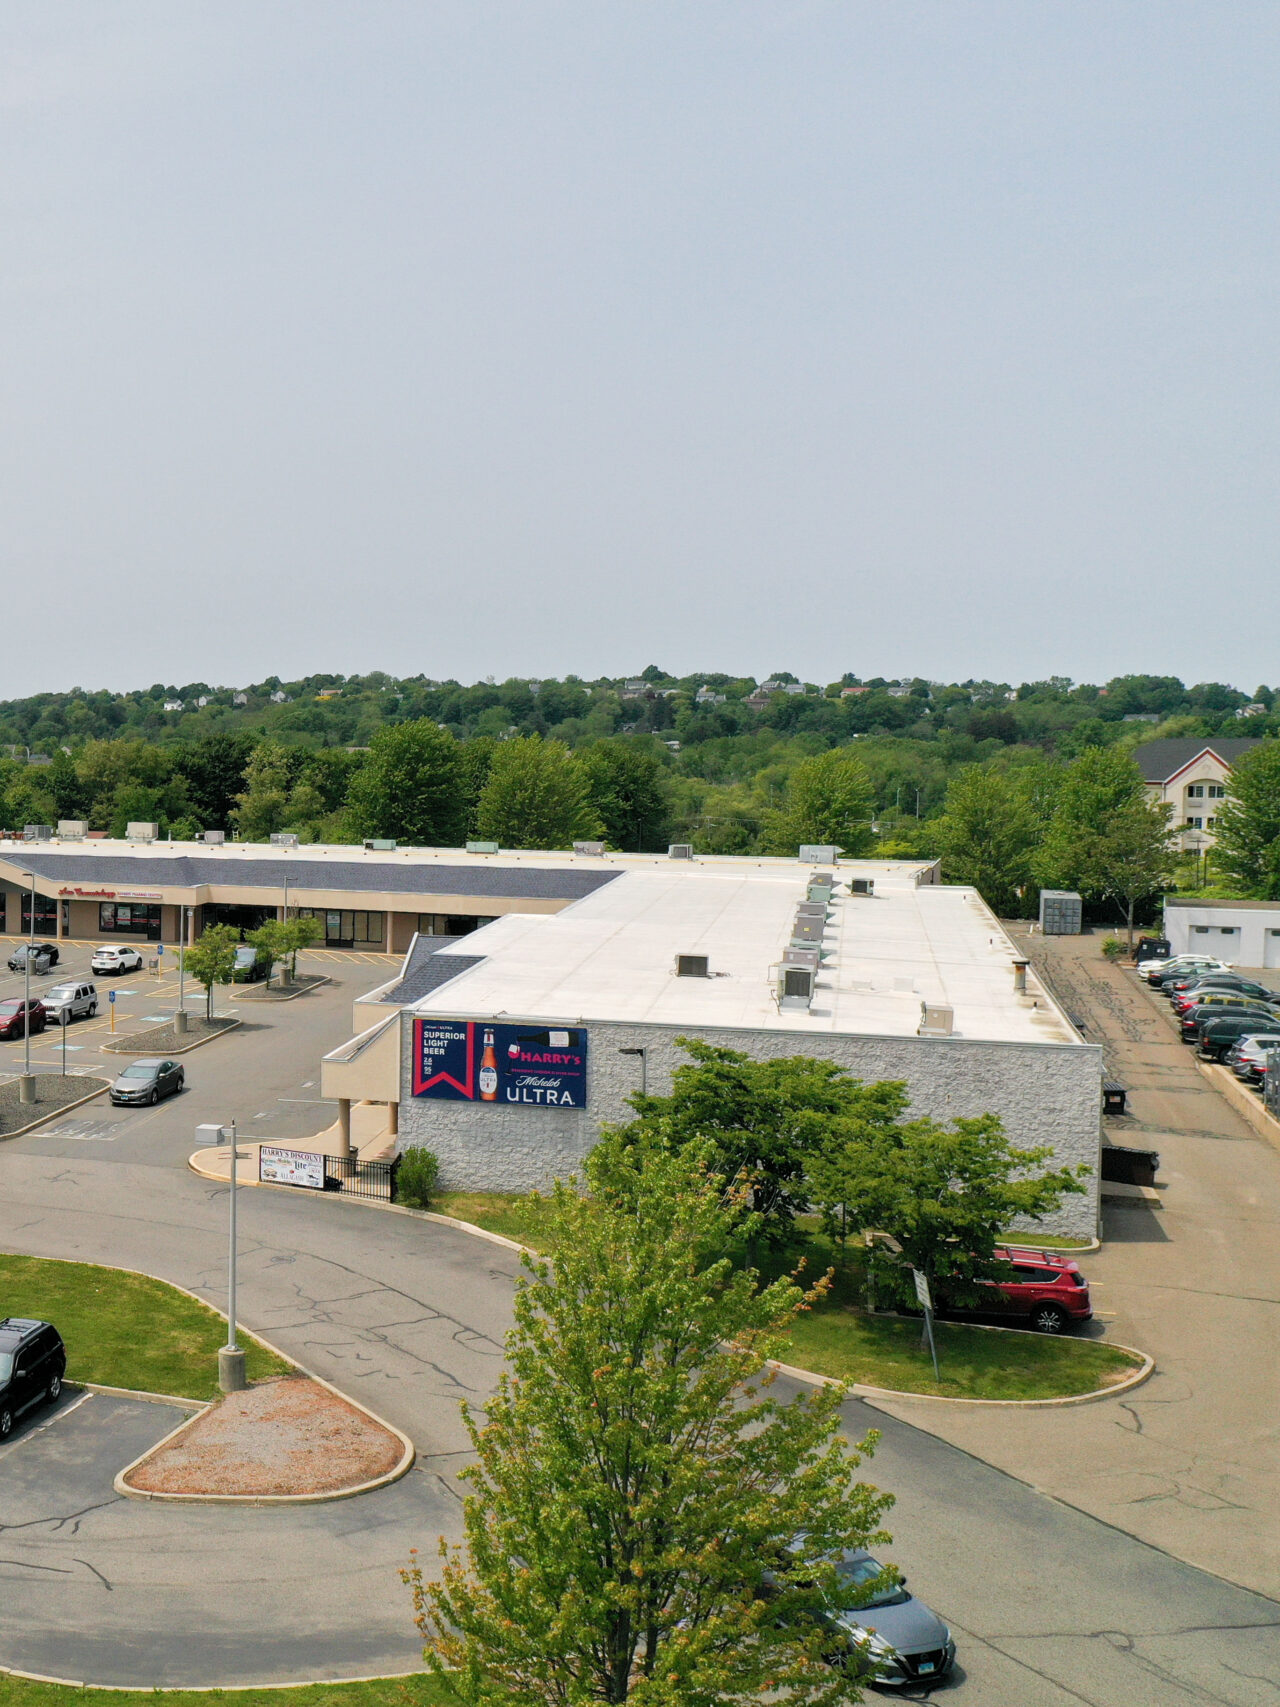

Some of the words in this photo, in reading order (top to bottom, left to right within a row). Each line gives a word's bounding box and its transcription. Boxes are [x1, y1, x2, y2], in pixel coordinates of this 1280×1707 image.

[423, 1031, 466, 1041] SUPERIOR
[423, 1039, 449, 1047] LIGHT
[423, 1047, 445, 1055] BEER
[515, 1075, 562, 1088] Michelob
[507, 1087, 574, 1105] ULTRA
[262, 1148, 289, 1158] HARRY'S
[290, 1152, 322, 1163] DISCOUNT
[294, 1160, 308, 1170] Lite
